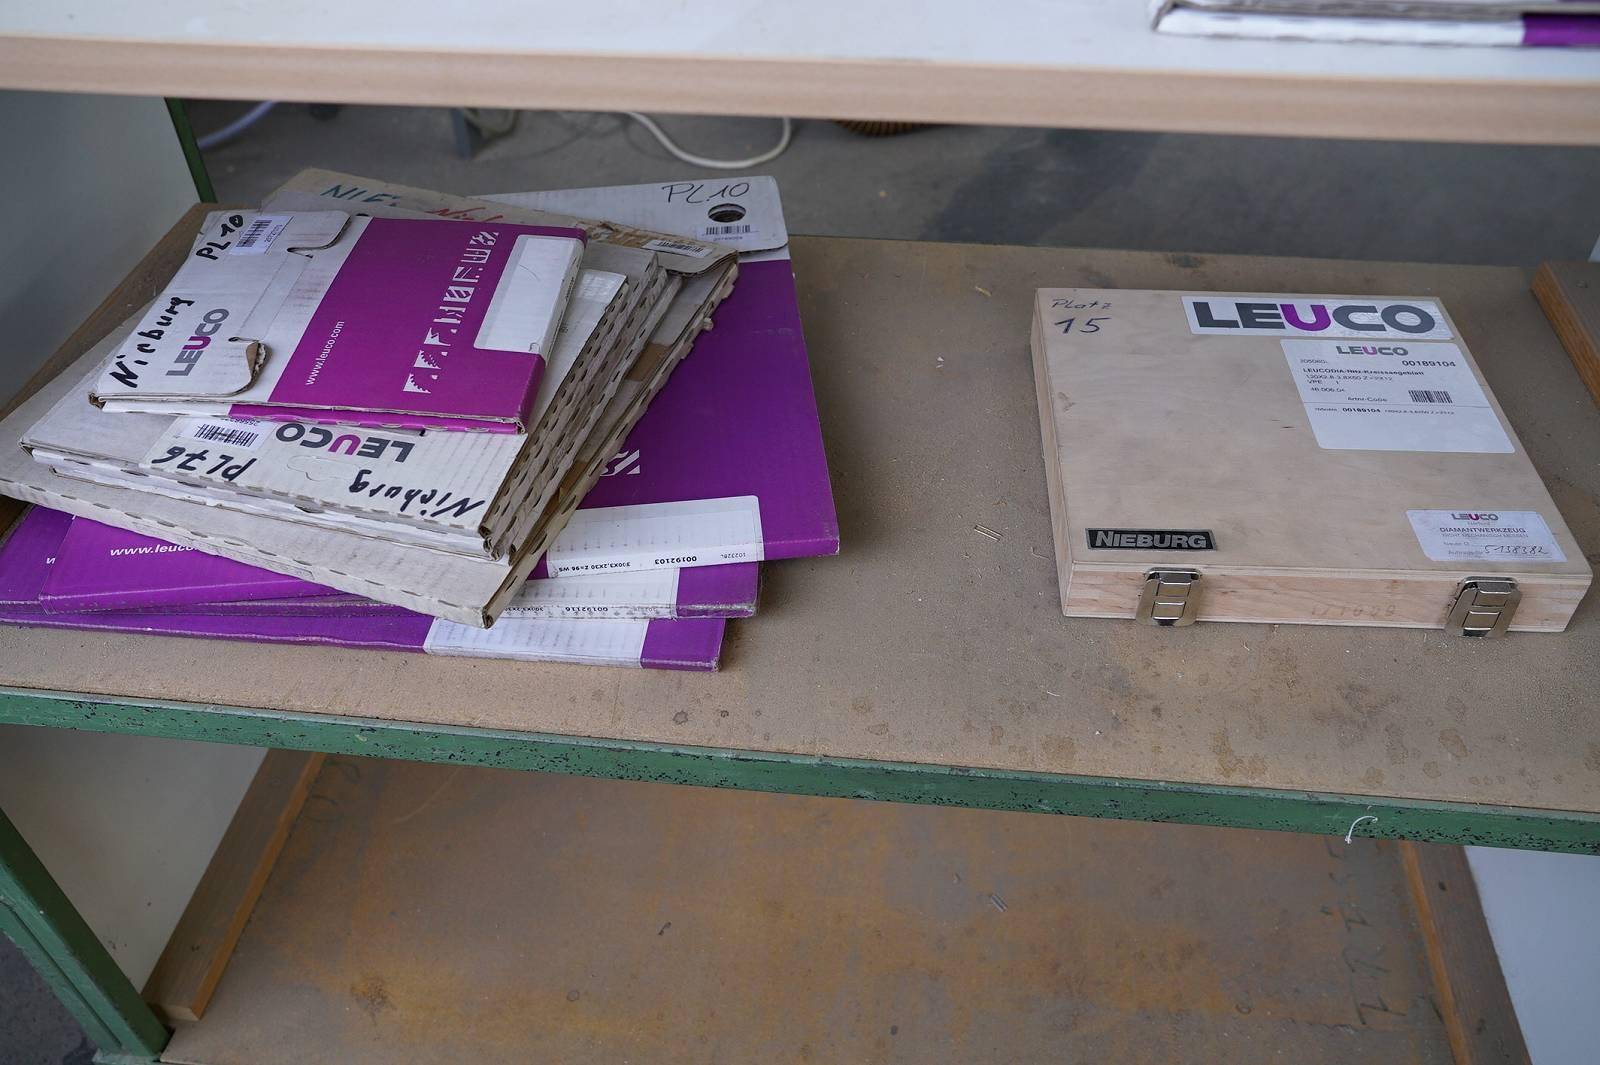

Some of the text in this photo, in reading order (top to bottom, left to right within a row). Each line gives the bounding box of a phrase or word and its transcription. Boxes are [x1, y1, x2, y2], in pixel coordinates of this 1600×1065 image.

[195, 214, 244, 260] PL 10
[1054, 317, 1112, 334] 15
[1193, 300, 1437, 333] LEUCO
[165, 308, 230, 376] LEUCO
[305, 320, 345, 386] www.leuco.com
[1336, 345, 1409, 356] LEUCO
[275, 422, 415, 463] LEUCO
[152, 446, 257, 482] PL 76
[1451, 513, 1499, 521] LEUCO
[1095, 531, 1206, 548] NIEBURG
[654, 555, 697, 565] 00192103
